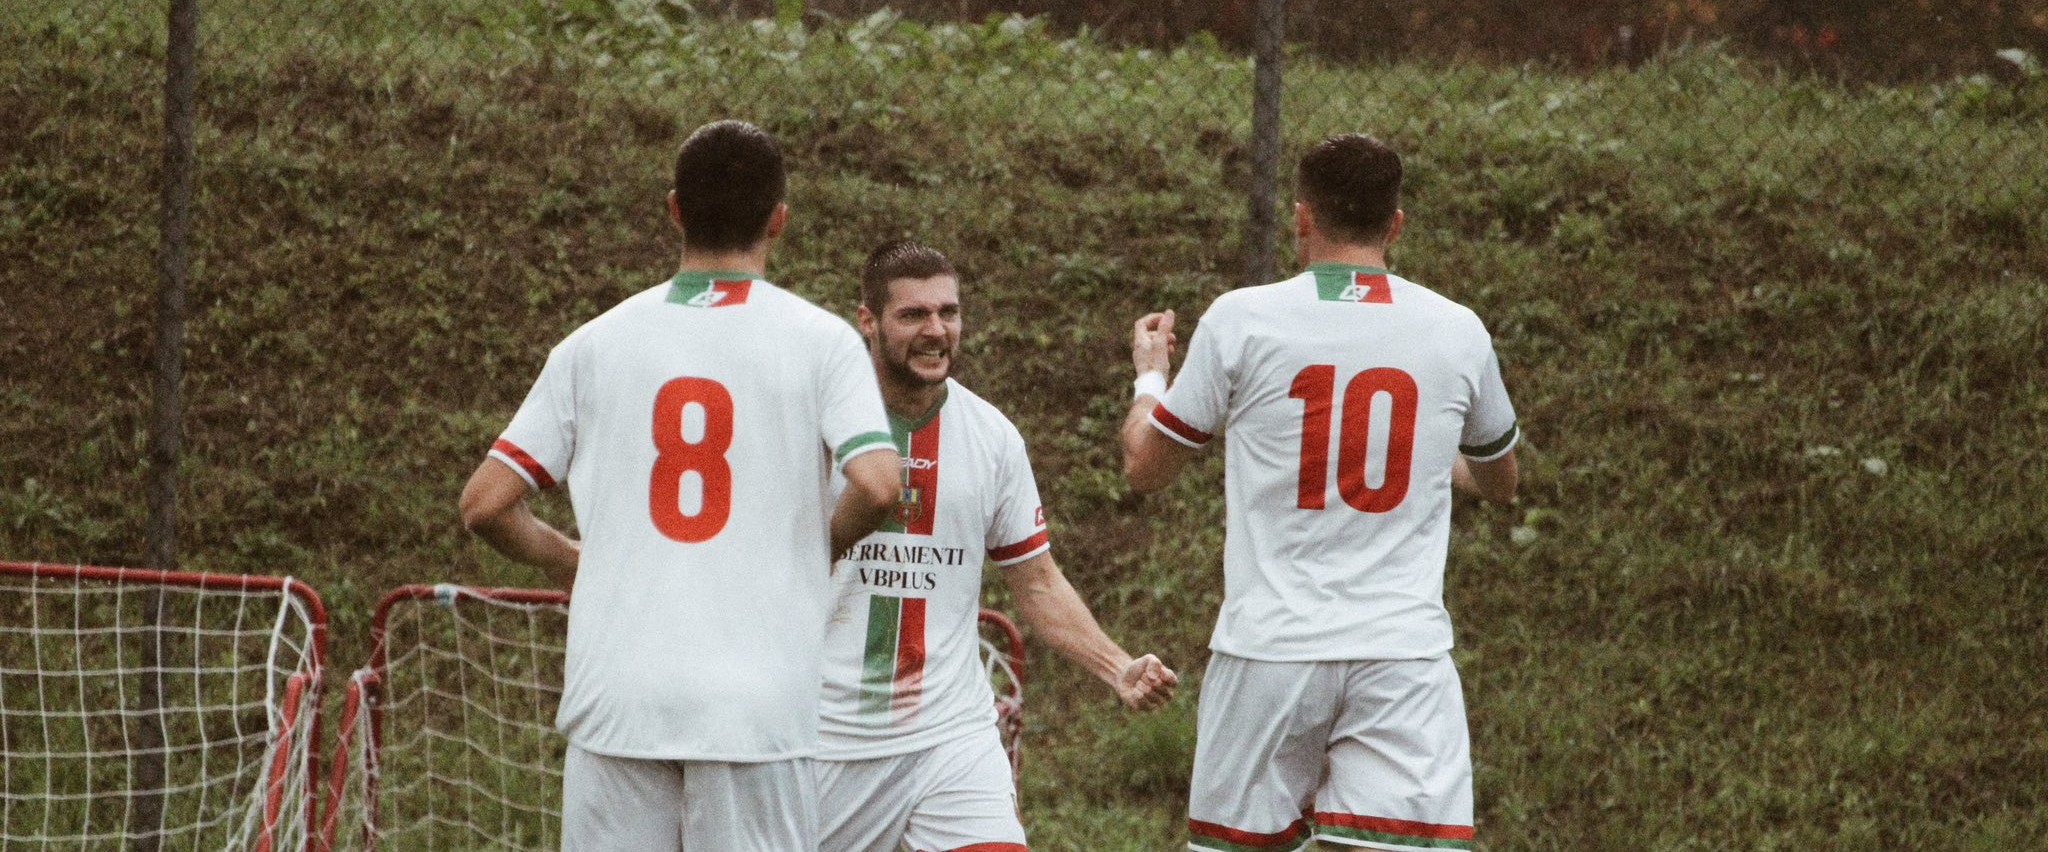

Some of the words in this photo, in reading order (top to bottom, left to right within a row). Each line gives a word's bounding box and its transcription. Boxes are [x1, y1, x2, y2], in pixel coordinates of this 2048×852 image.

[650, 376, 733, 543] 8
[901, 457, 937, 469] EADY
[1288, 364, 1418, 513] 10
[859, 568, 936, 590] VBPLUS
